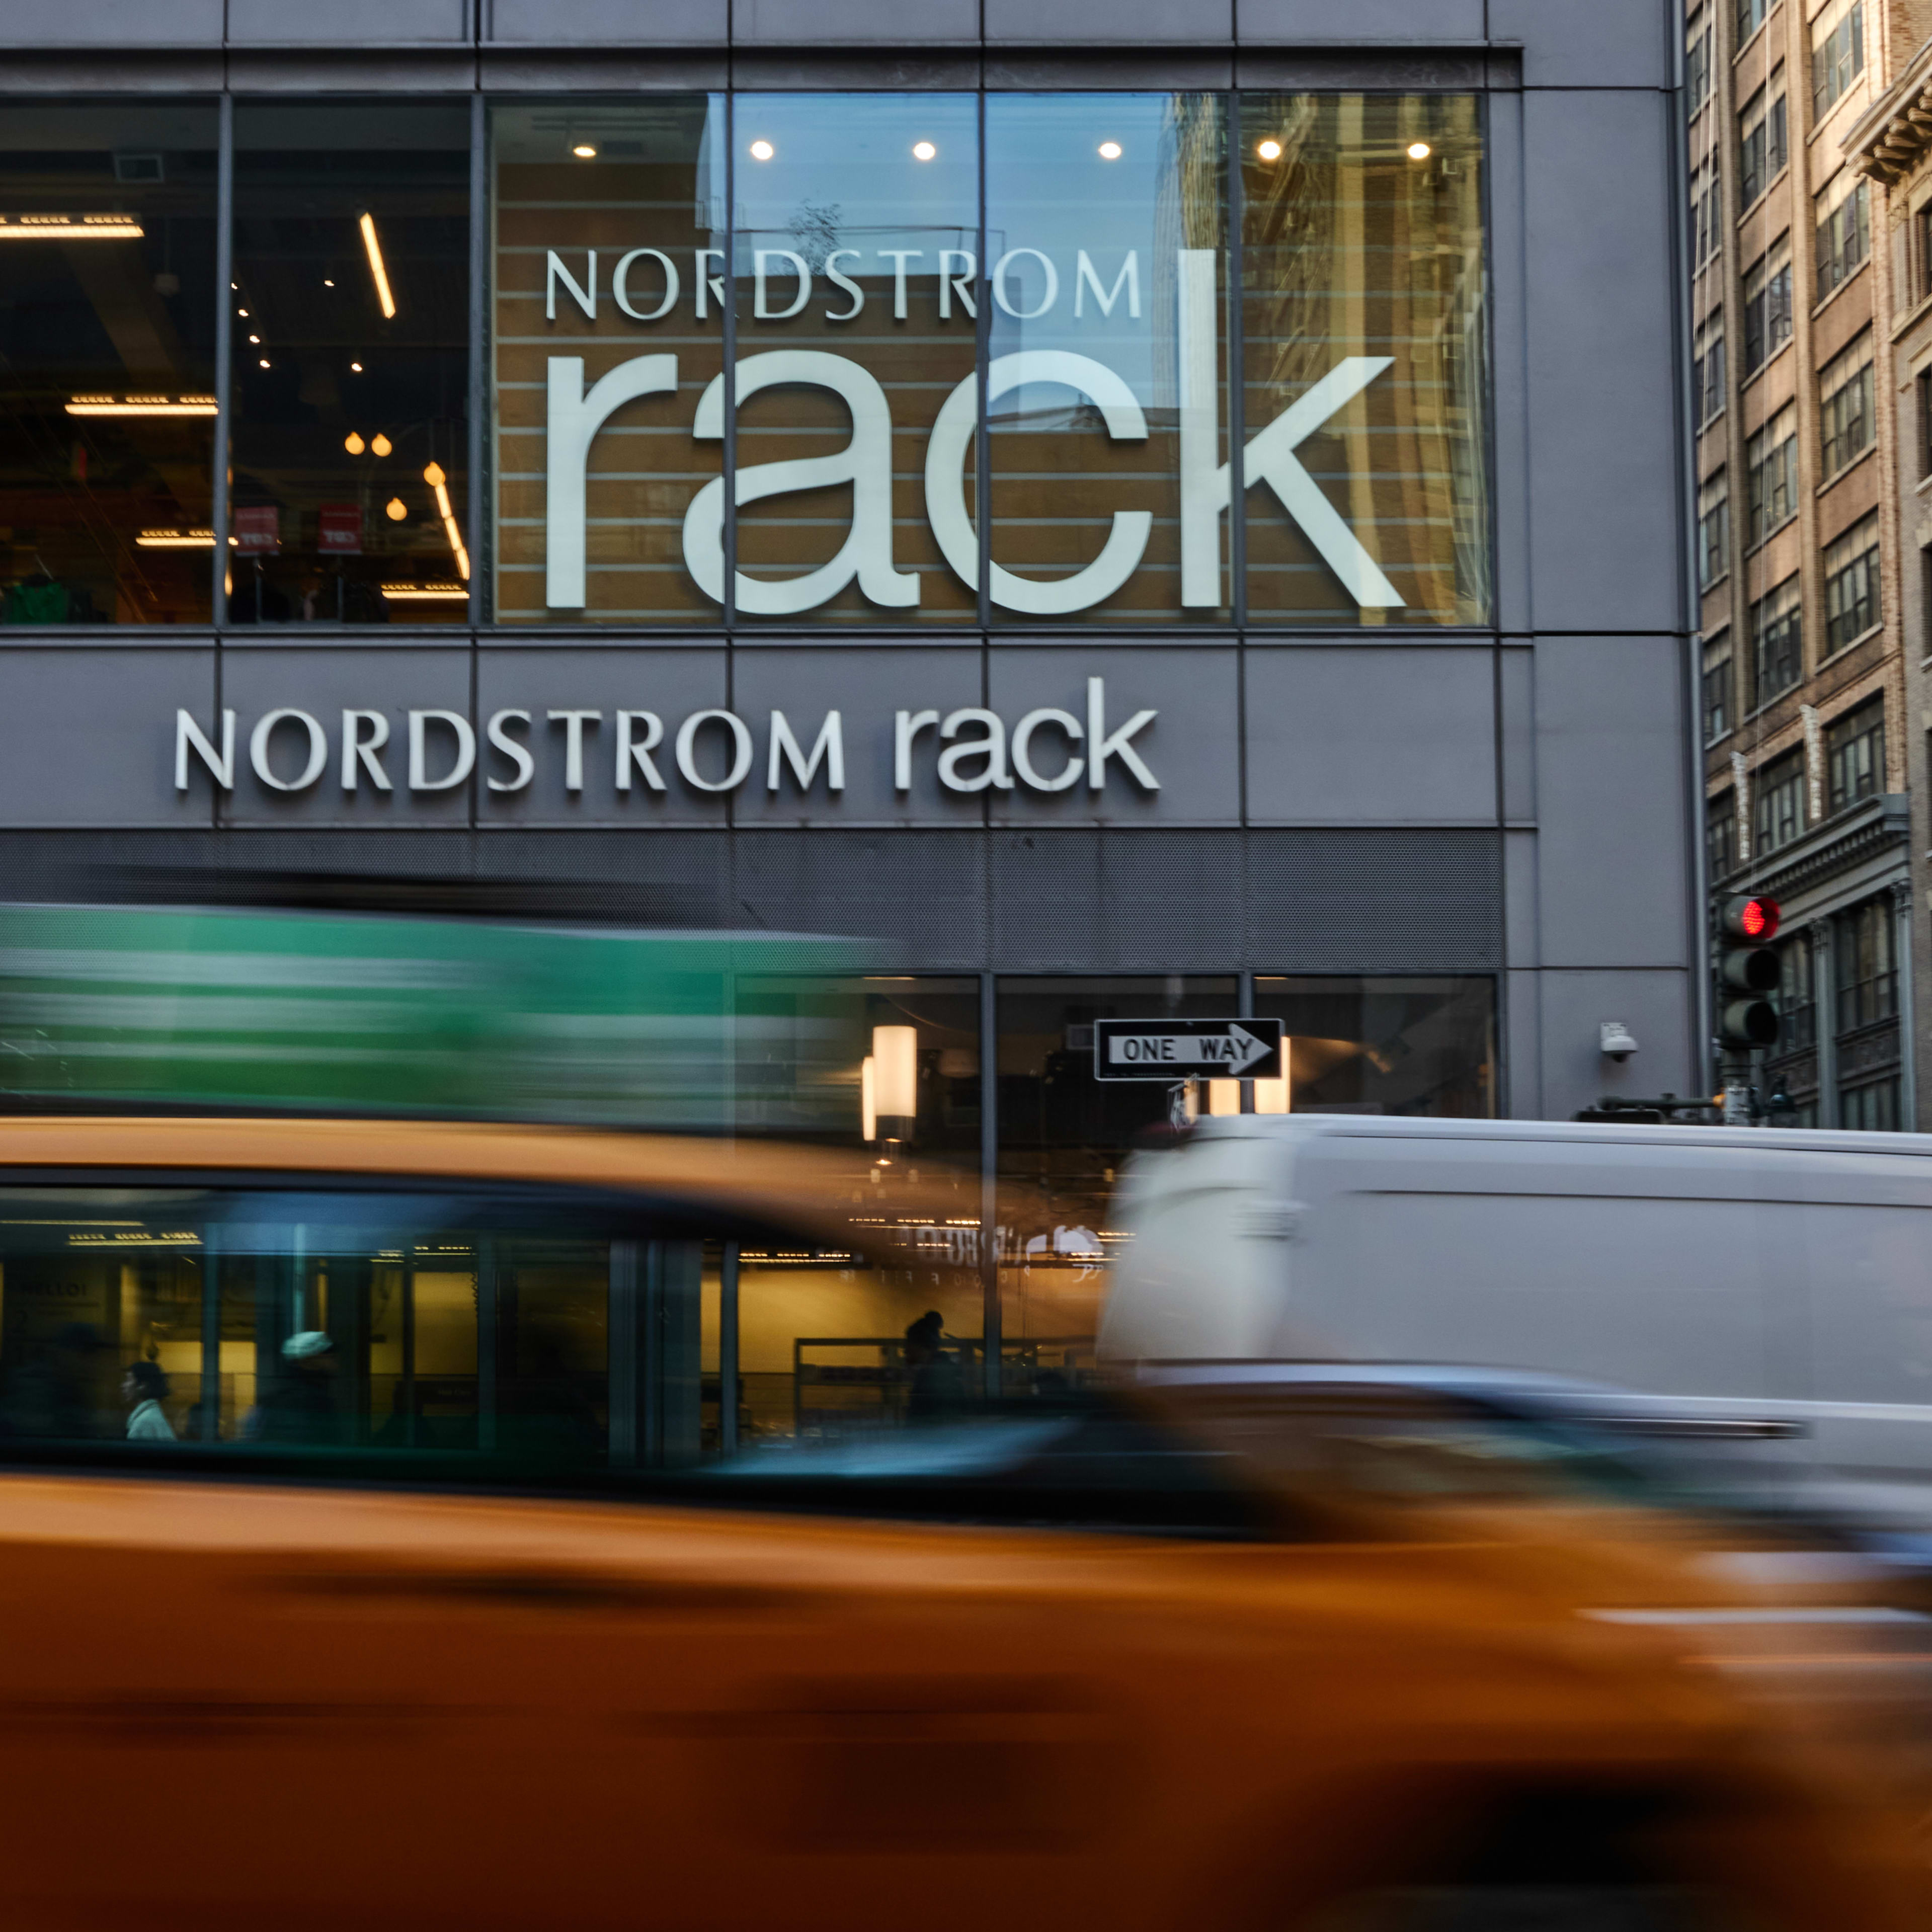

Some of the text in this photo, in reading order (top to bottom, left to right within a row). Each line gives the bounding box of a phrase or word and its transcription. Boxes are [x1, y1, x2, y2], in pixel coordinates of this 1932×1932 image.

[547, 249, 1142, 320] NORDSTROM
[546, 249, 1405, 614] rack
[174, 677, 1160, 791] NORDSTROM rack
[1123, 1038, 1254, 1060] ONE WAY
